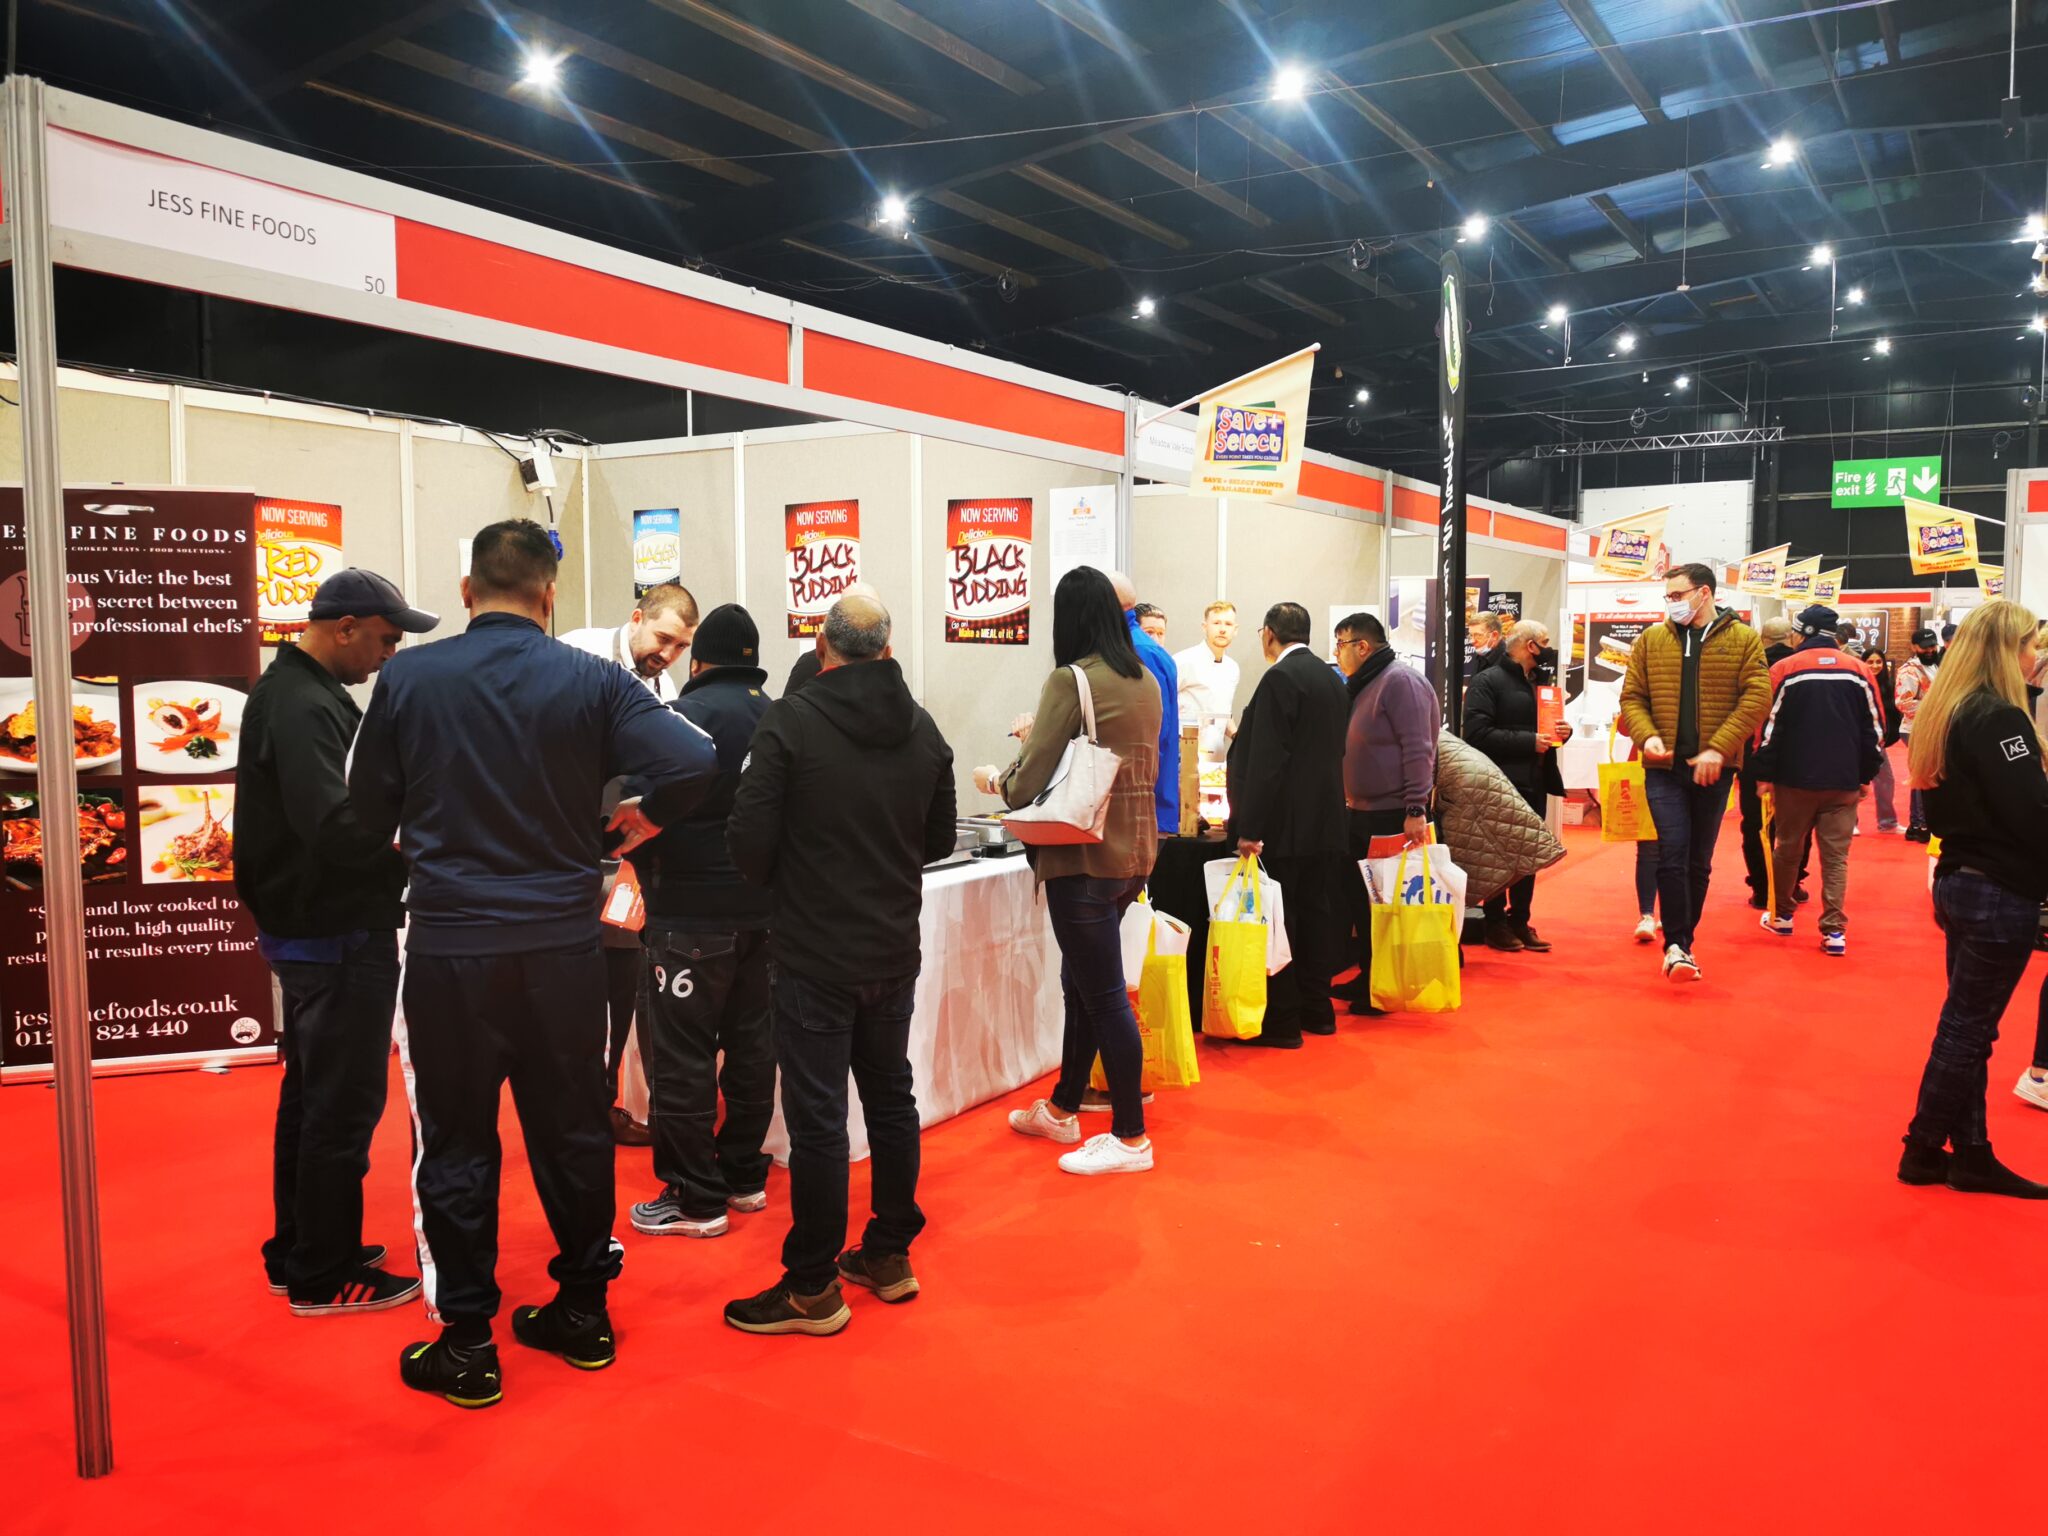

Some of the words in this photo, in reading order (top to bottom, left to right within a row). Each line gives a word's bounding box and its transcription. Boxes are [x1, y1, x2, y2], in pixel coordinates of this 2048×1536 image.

[148, 188, 194, 217] JESS
[201, 201, 245, 229] FINE
[252, 214, 317, 245] FOODS
[364, 275, 385, 295] 50
[1214, 429, 1281, 454] Select
[1835, 472, 1861, 484] Fire
[1835, 485, 1860, 496] exit
[261, 506, 285, 523] NOW
[287, 509, 328, 528] SERVING
[796, 510, 814, 526] NOW
[816, 508, 848, 524] SERVING
[960, 508, 981, 523] NOW
[982, 507, 1019, 523] SERVING
[70, 526, 137, 540] FINE
[152, 528, 247, 543] FOODS
[795, 529, 826, 546] Delicious
[957, 527, 993, 545] Delicious
[261, 542, 322, 581] RED
[789, 542, 856, 580] BLACK
[951, 543, 1026, 581] BLACK
[66, 573, 99, 584] ous
[104, 569, 152, 584] Vide:
[158, 569, 188, 585] the
[193, 569, 232, 586] best
[789, 568, 858, 608] PUDDING
[948, 571, 1027, 610] PUDDING
[97, 595, 153, 609] secret
[159, 593, 237, 609] between
[72, 618, 187, 635] professional
[951, 619, 960, 630] Go
[1856, 617, 1880, 627] YOU
[958, 627, 975, 638] Make
[981, 628, 998, 639] MEAL
[998, 628, 1005, 639] of
[2010, 740, 2026, 756] AG
[86, 901, 118, 917] and
[122, 901, 153, 915] low
[157, 897, 217, 913] cooked
[222, 897, 239, 911] to
[134, 919, 172, 938] high
[176, 917, 235, 935] quality
[105, 943, 163, 960] results
[167, 939, 213, 956] every
[655, 956, 694, 998] 96
[96, 1023, 139, 1041] 824
[146, 1019, 188, 1037] 440
